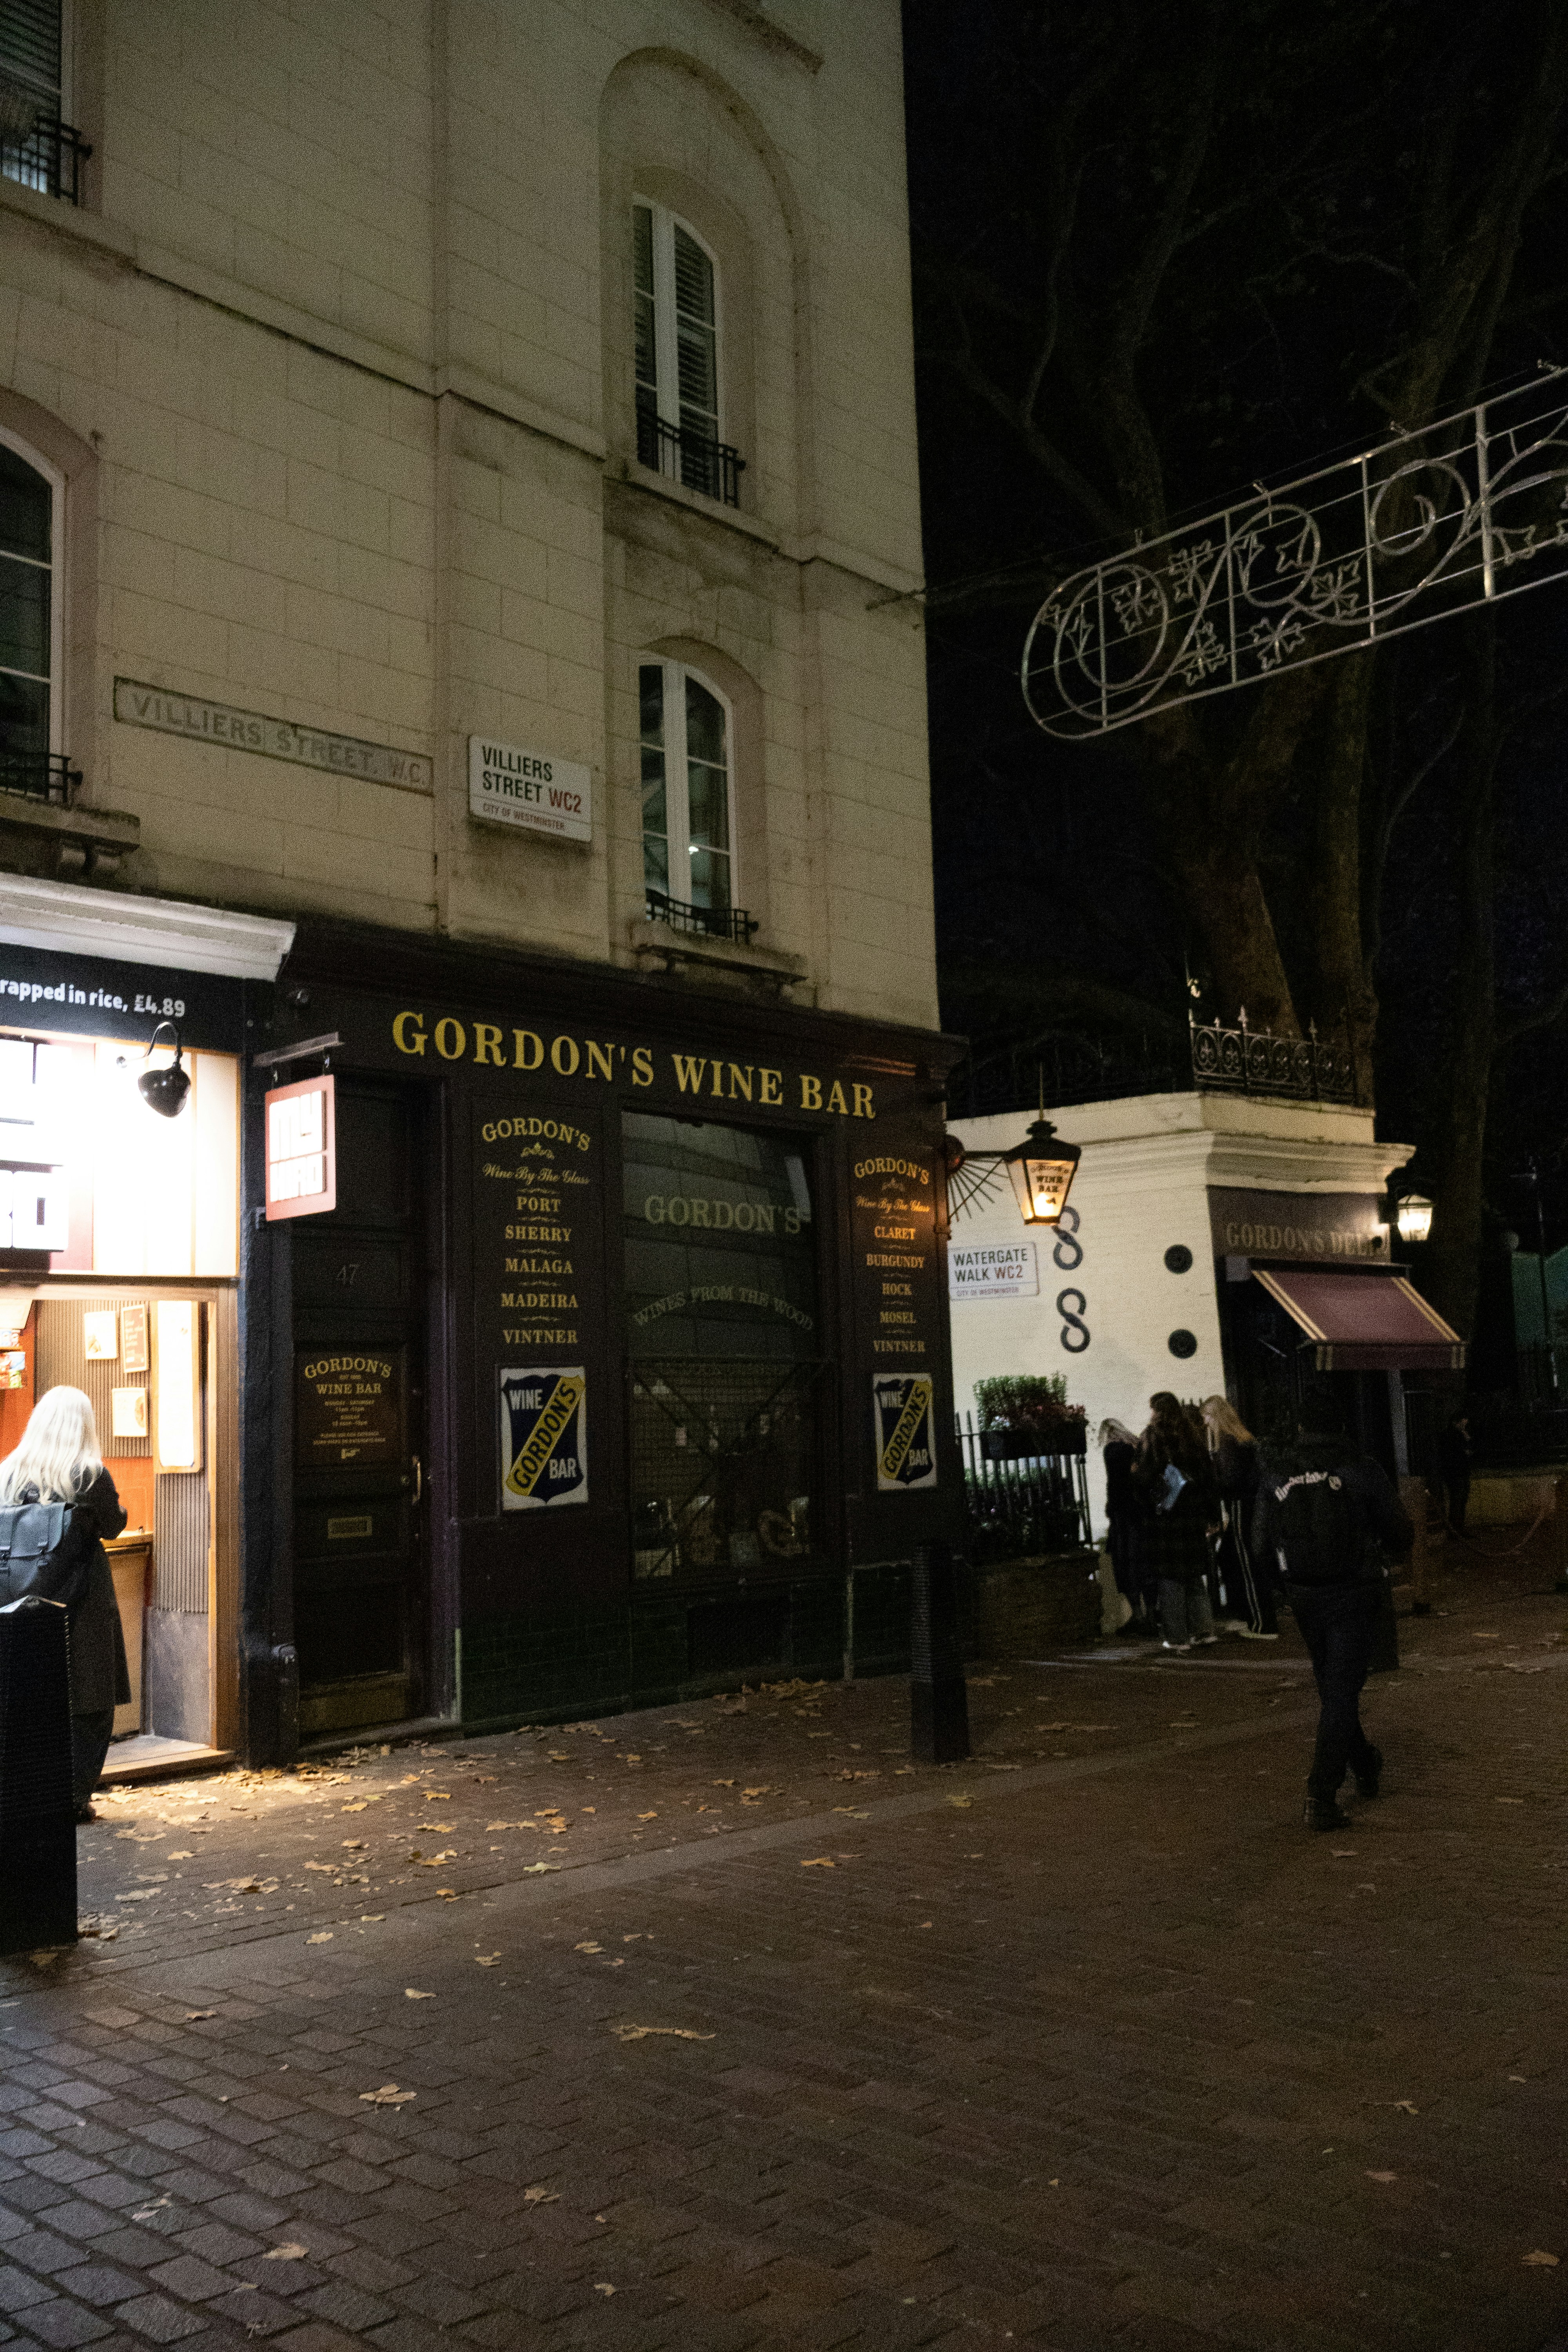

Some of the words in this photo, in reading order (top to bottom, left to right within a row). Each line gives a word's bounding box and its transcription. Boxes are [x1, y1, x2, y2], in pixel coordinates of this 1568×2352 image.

[132, 692, 262, 745] VILLIERS
[482, 746, 552, 782] VILLIERS
[483, 771, 542, 802] STREET
[549, 788, 581, 813] WC2
[69, 984, 86, 1004] in
[89, 988, 128, 1012] rice,
[134, 994, 185, 1017] £4.89
[392, 1010, 655, 1087] GORDON'S
[671, 1053, 784, 1106] WINE
[800, 1074, 877, 1119] BAR
[482, 1118, 591, 1151] GORDON'S
[482, 1163, 514, 1179] Wine
[515, 1166, 536, 1185] By
[537, 1168, 561, 1182] The
[562, 1169, 591, 1185] Glass
[855, 1158, 929, 1184] GORDON'S
[516, 1196, 561, 1212] PORT
[855, 1196, 877, 1208] Wine
[878, 1198, 892, 1214] By
[645, 1195, 801, 1234] GORDON'S
[505, 1224, 572, 1242] SHERRY
[875, 1226, 916, 1240] CLARET
[505, 1258, 573, 1274] MALAGA
[866, 1254, 924, 1268] BURGUNDY
[953, 1249, 1027, 1266] WATERGATE
[955, 1268, 990, 1282] WALK
[995, 1264, 1023, 1279] WC2
[882, 1283, 912, 1295] HOCK
[501, 1293, 579, 1308] MADEIRA
[633, 1291, 686, 1326] WINES
[691, 1286, 734, 1303] FROM
[739, 1287, 769, 1307] THE
[773, 1298, 813, 1330] WOOD
[880, 1311, 916, 1323] MOSEL
[503, 1329, 578, 1344] VINTNER
[873, 1340, 925, 1352] VINTNER
[305, 1357, 392, 1379] GORDON'S
[316, 1384, 352, 1394] WINE
[356, 1383, 382, 1394] BAR
[509, 1389, 543, 1410] WINE
[880, 1391, 904, 1408] WINE
[514, 1383, 575, 1488] GORDON'S
[909, 1448, 928, 1466] BAR
[549, 1457, 576, 1479] BAR
